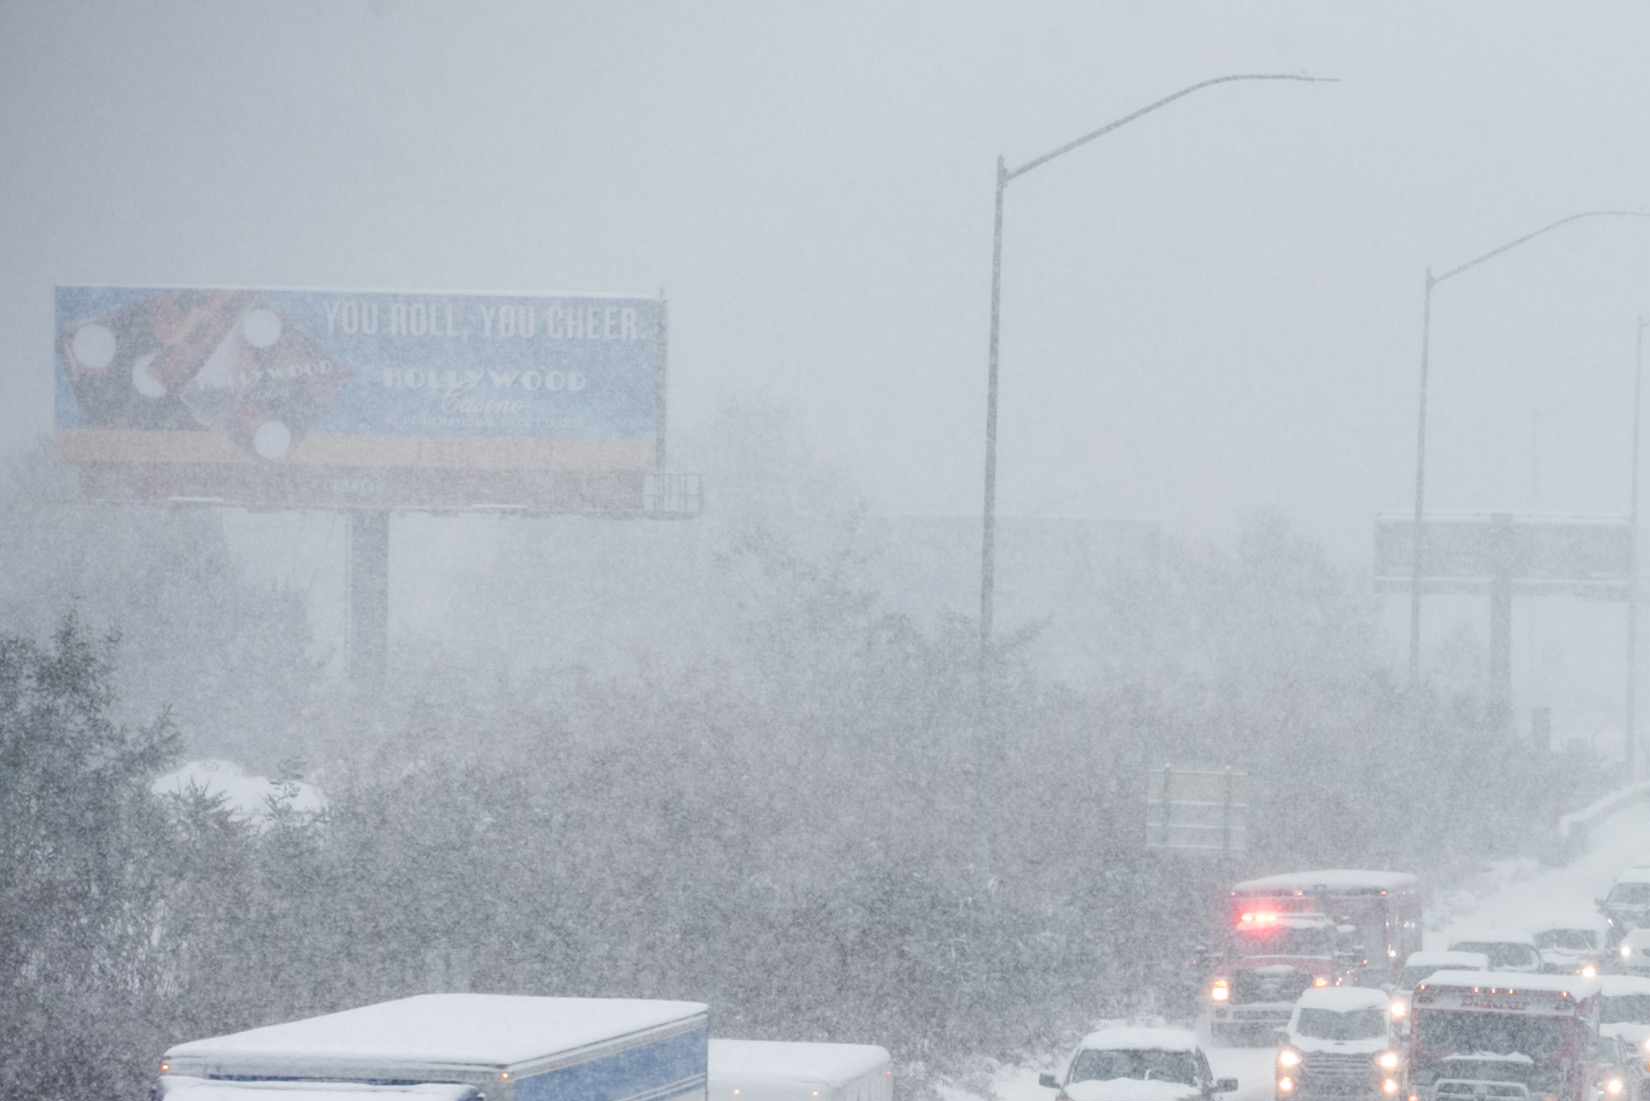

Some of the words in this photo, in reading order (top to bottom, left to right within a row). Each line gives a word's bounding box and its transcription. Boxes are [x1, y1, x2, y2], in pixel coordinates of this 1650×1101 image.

[325, 302, 379, 335] YOU
[390, 303, 469, 340] ROLL,
[481, 304, 535, 338] YOU
[547, 305, 647, 341] CHEER.
[383, 367, 588, 391] HOLLYWOOD
[440, 385, 523, 414] Casino
